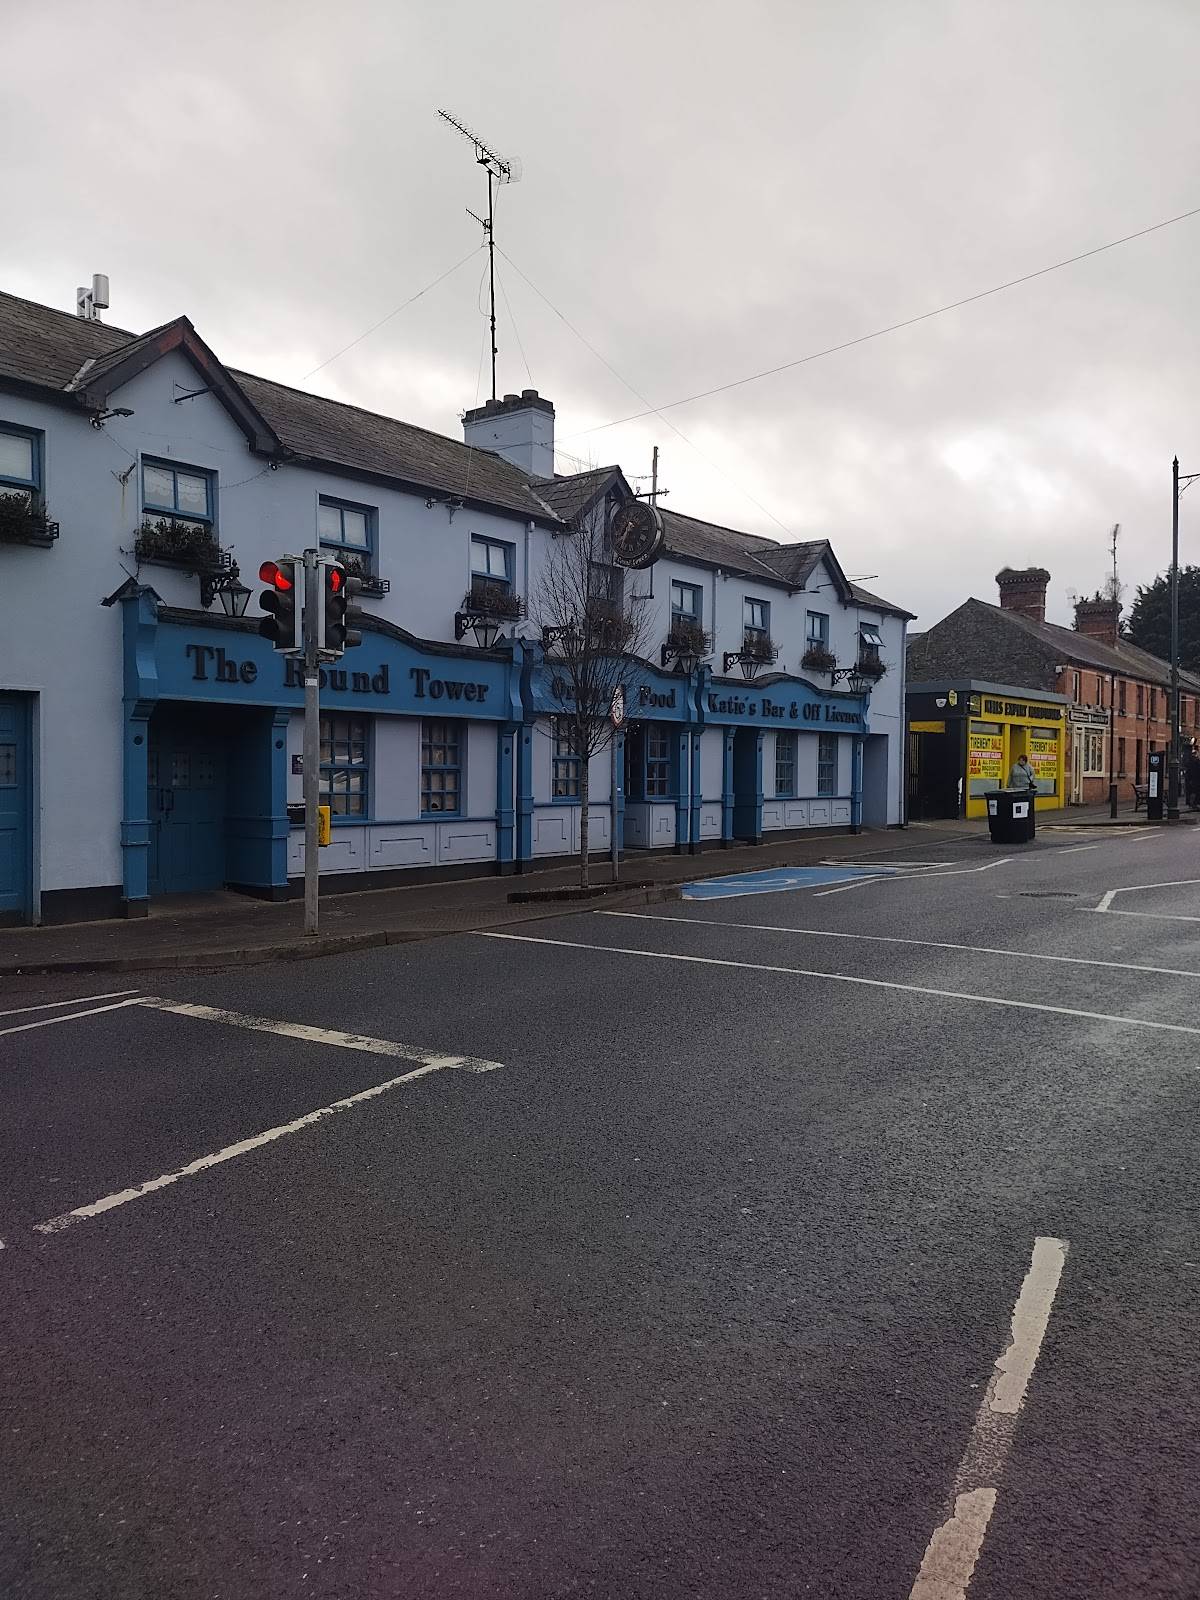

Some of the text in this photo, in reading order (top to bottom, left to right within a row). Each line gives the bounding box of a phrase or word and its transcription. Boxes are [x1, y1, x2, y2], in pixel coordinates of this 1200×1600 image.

[186, 644, 489, 702] The Round Tower
[639, 686, 676, 709] Food
[761, 698, 785, 718] Bar
[789, 702, 799, 720] &
